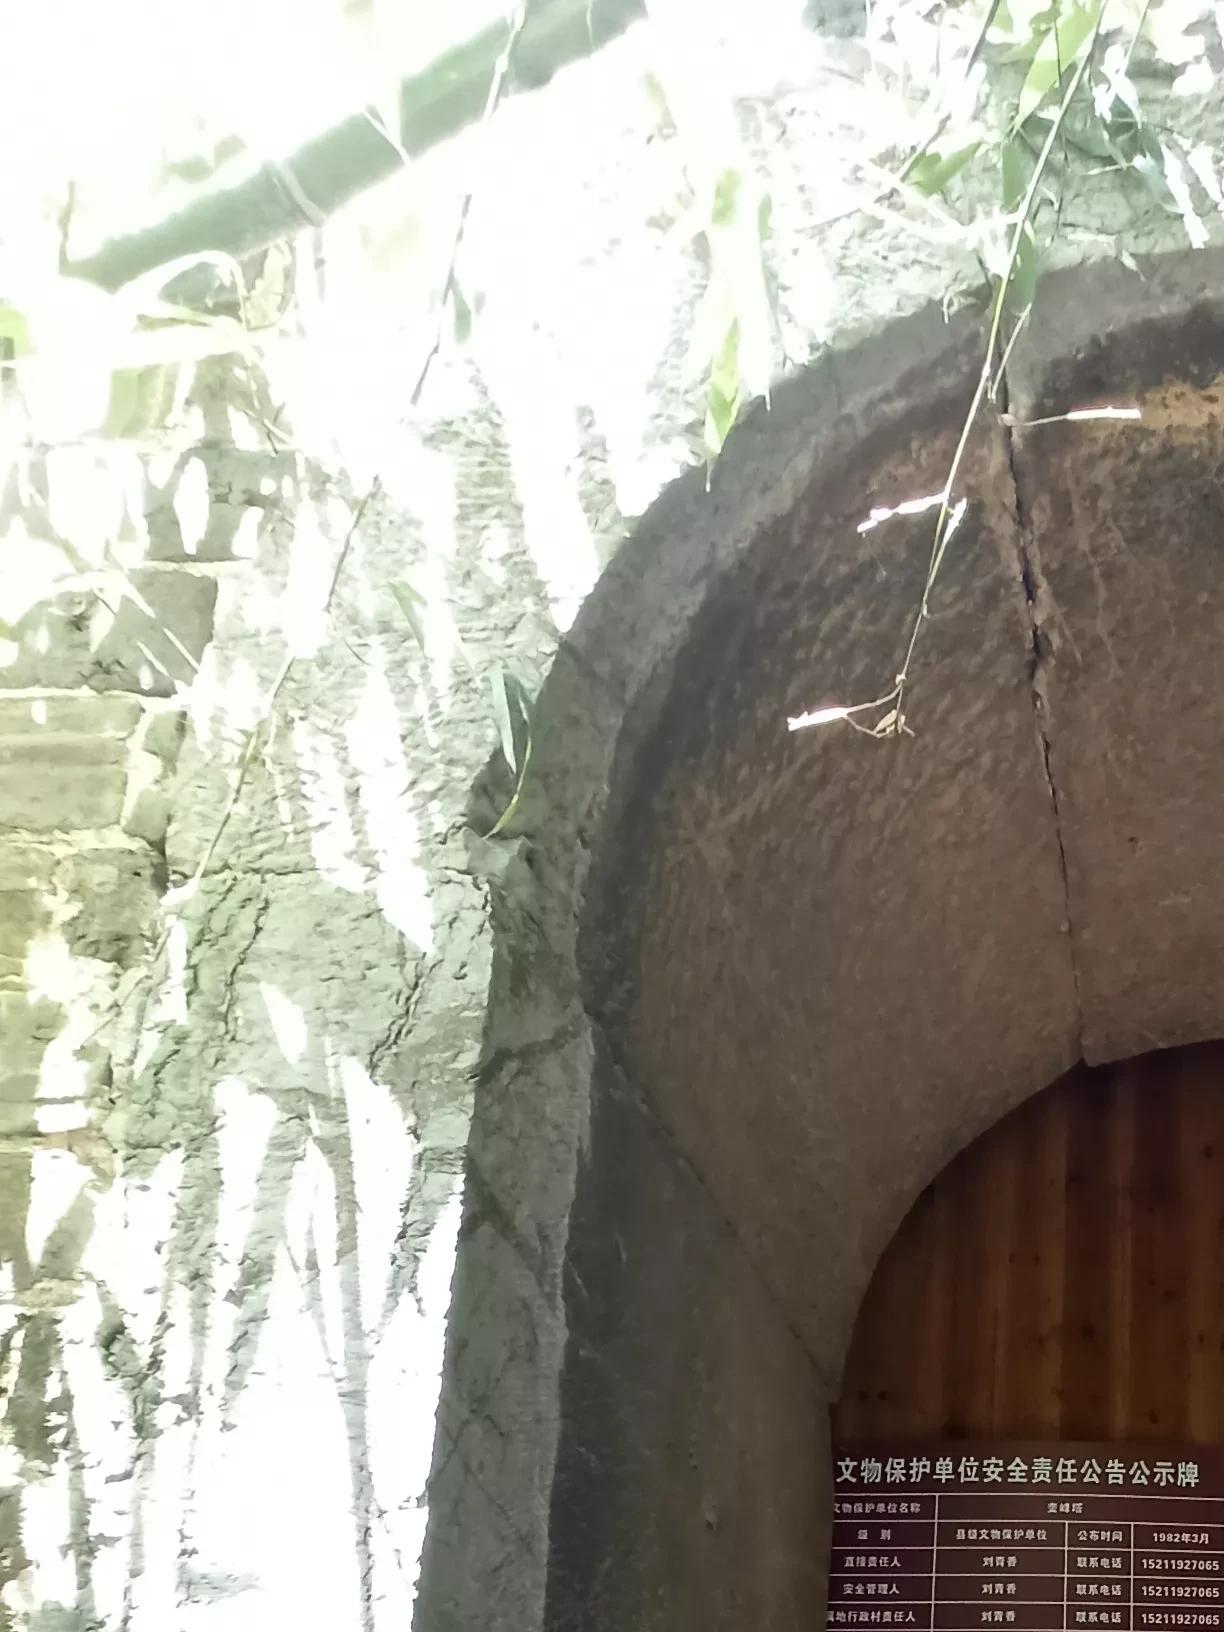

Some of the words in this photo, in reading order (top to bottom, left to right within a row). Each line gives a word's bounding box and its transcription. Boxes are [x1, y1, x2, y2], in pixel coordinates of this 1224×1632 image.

[836, 1456, 1199, 1488] 文物保护单位安全责任公告公示牌
[834, 1502, 921, 1514] 文物保护单位名称
[956, 1528, 1047, 1541] 县级文物保护单位
[1077, 1530, 1123, 1542] 公布时间
[1153, 1532, 1209, 1545] 1982年3月
[844, 1555, 901, 1568] 直接责任人
[1076, 1556, 1122, 1569] 联系电话
[1142, 1558, 1220, 1571] 15211927065
[843, 1583, 900, 1595] 安全管理人
[1075, 1583, 1122, 1596] 联系电话
[1141, 1585, 1220, 1598] 15211927065
[1075, 1611, 1122, 1624] 联系电话
[1141, 1613, 1220, 1626] 15211927065
